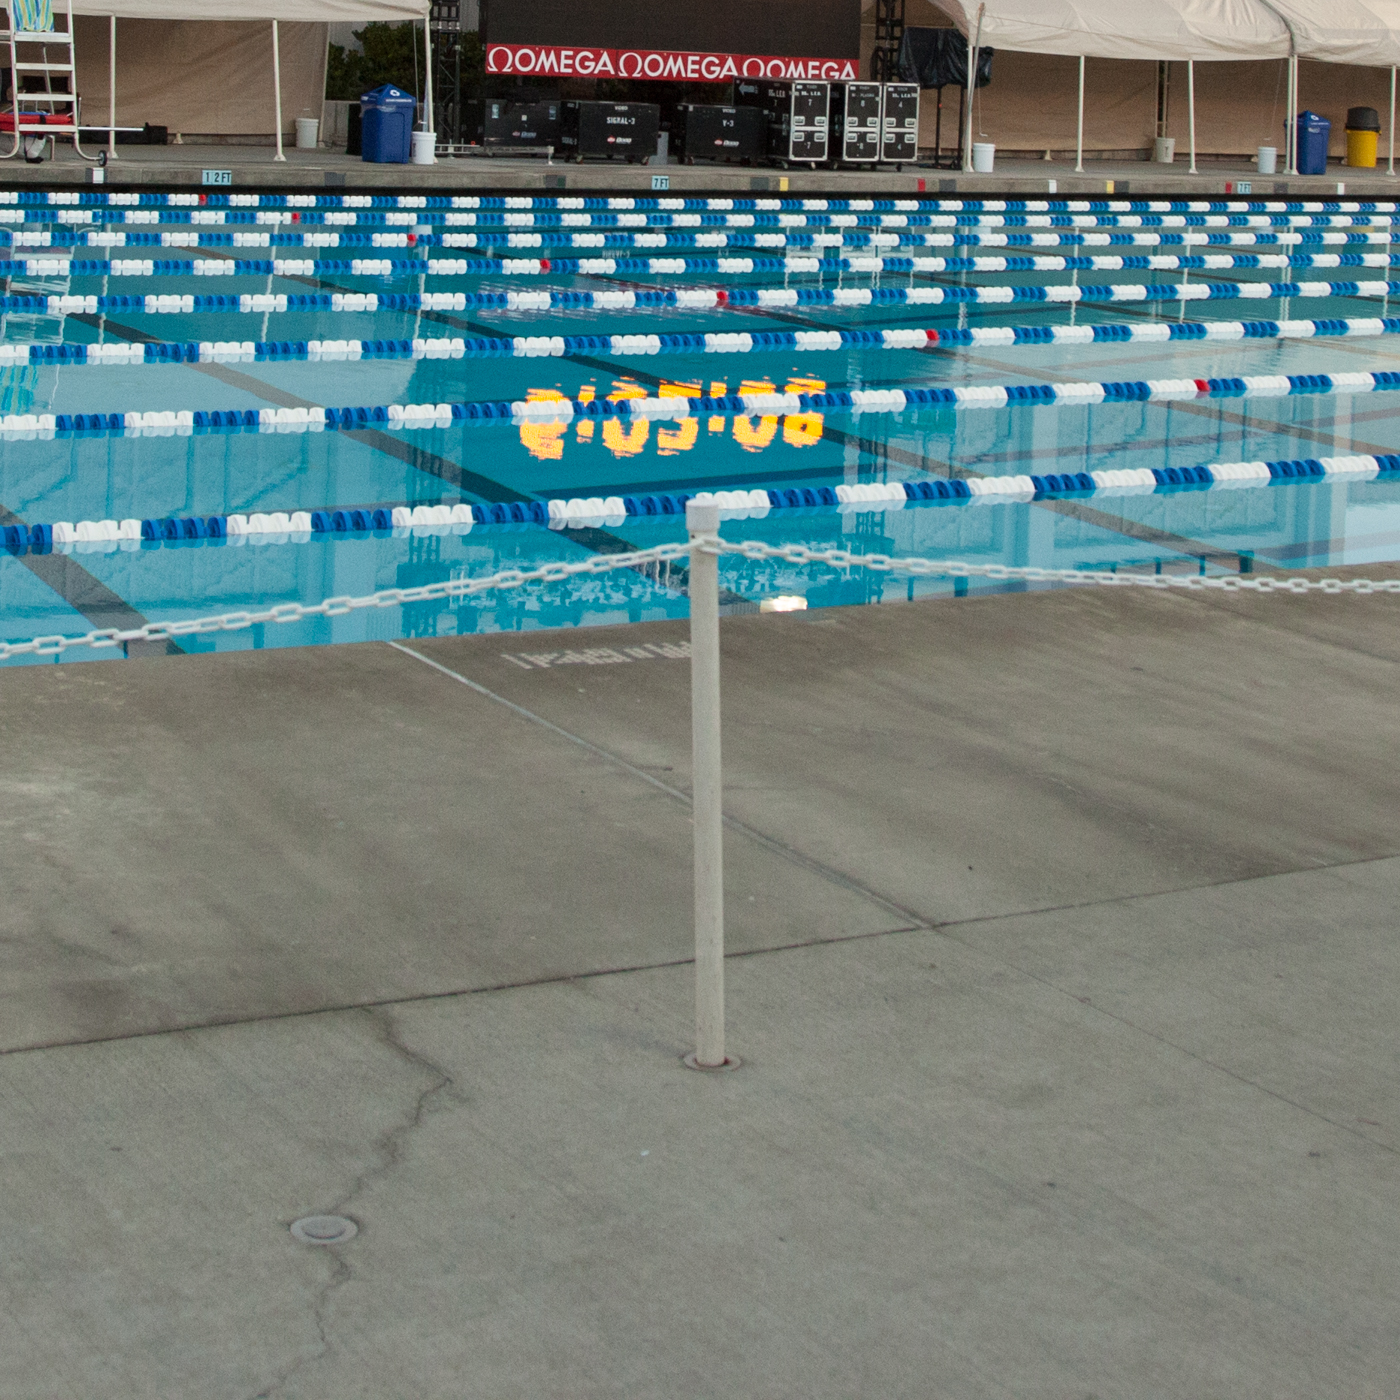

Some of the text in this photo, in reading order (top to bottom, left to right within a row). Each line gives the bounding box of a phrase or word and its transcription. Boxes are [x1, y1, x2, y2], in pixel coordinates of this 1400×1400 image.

[514, 48, 615, 74] OMEGA
[642, 54, 738, 79] OMEGA
[221, 172, 231, 183] FT
